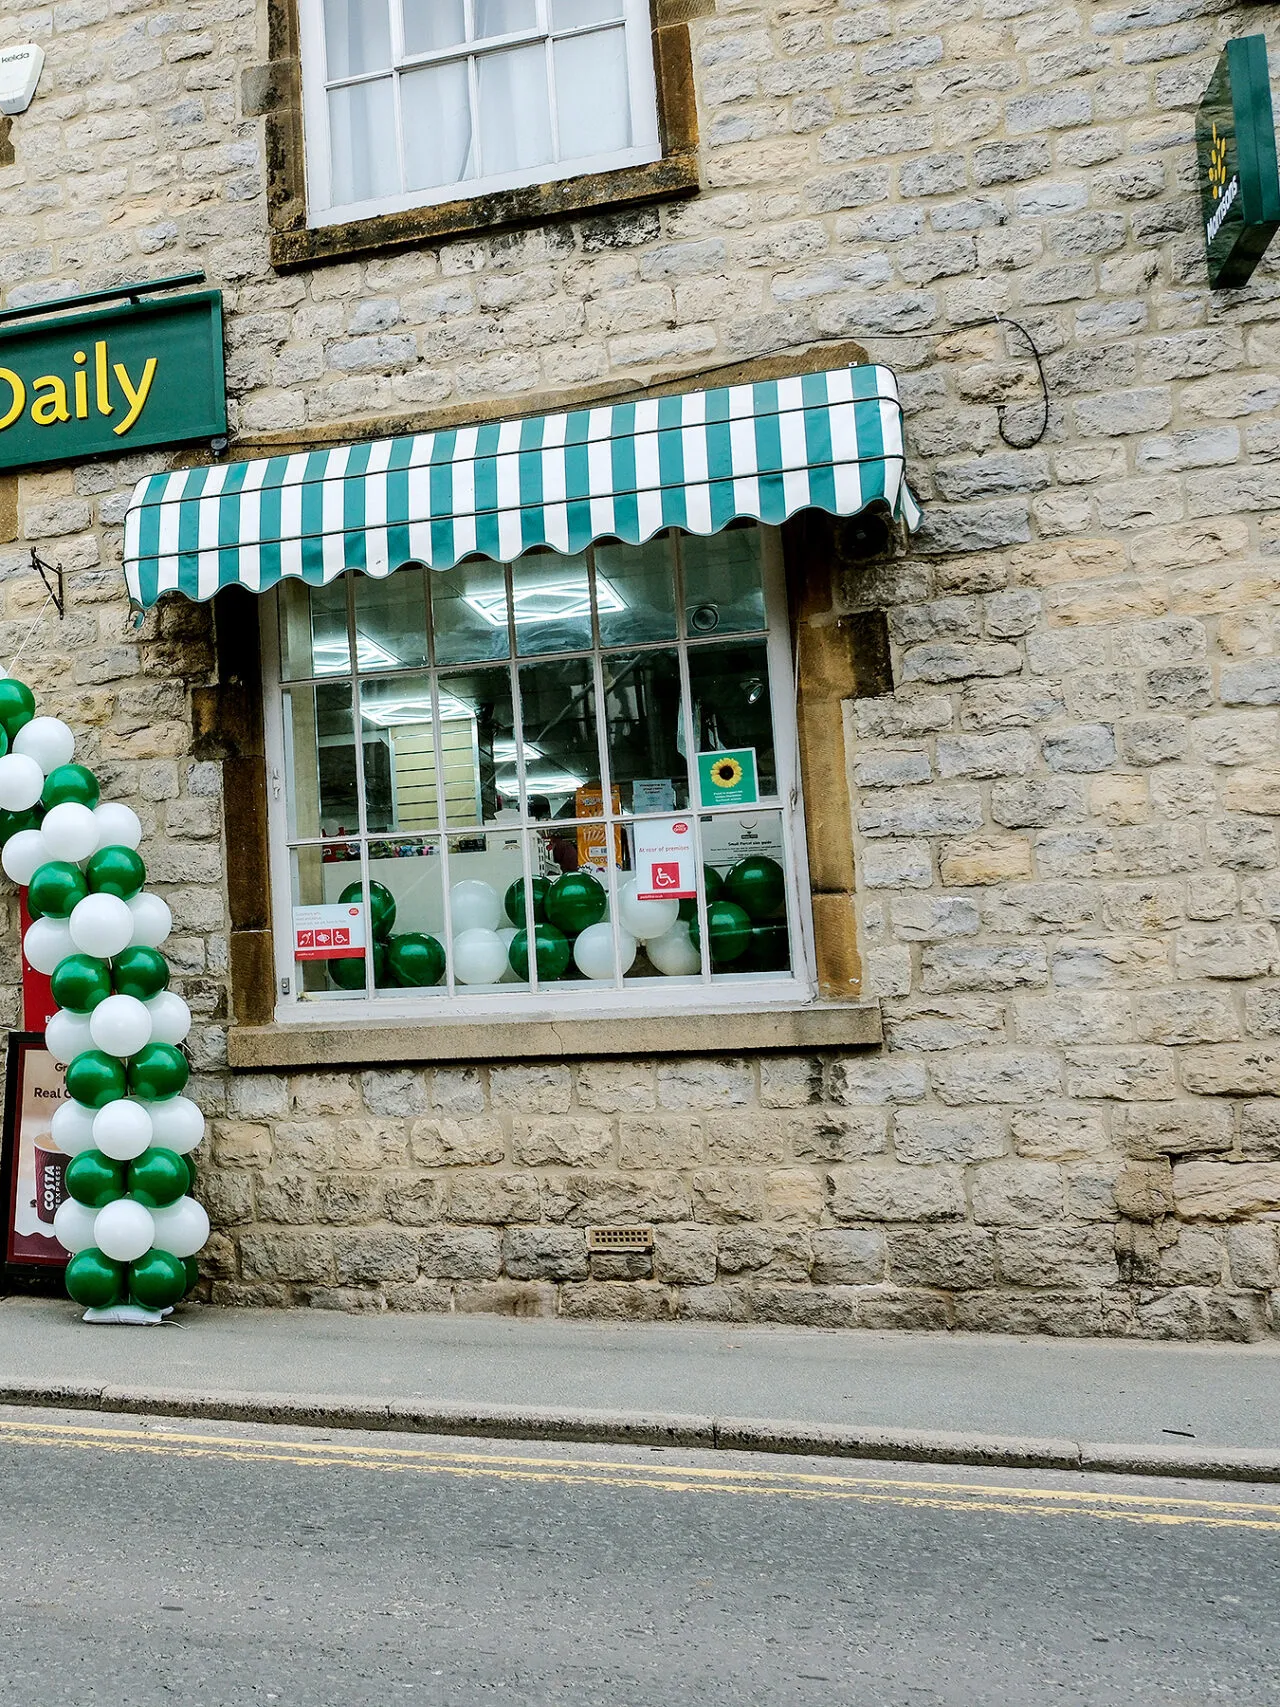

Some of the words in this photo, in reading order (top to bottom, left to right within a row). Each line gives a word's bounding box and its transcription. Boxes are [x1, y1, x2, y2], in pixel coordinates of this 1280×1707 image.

[1207, 175, 1237, 246] Morrisons
[54, 1062, 68, 1072] Gr
[33, 1087, 61, 1099] Real
[44, 1165, 55, 1211] COSTA
